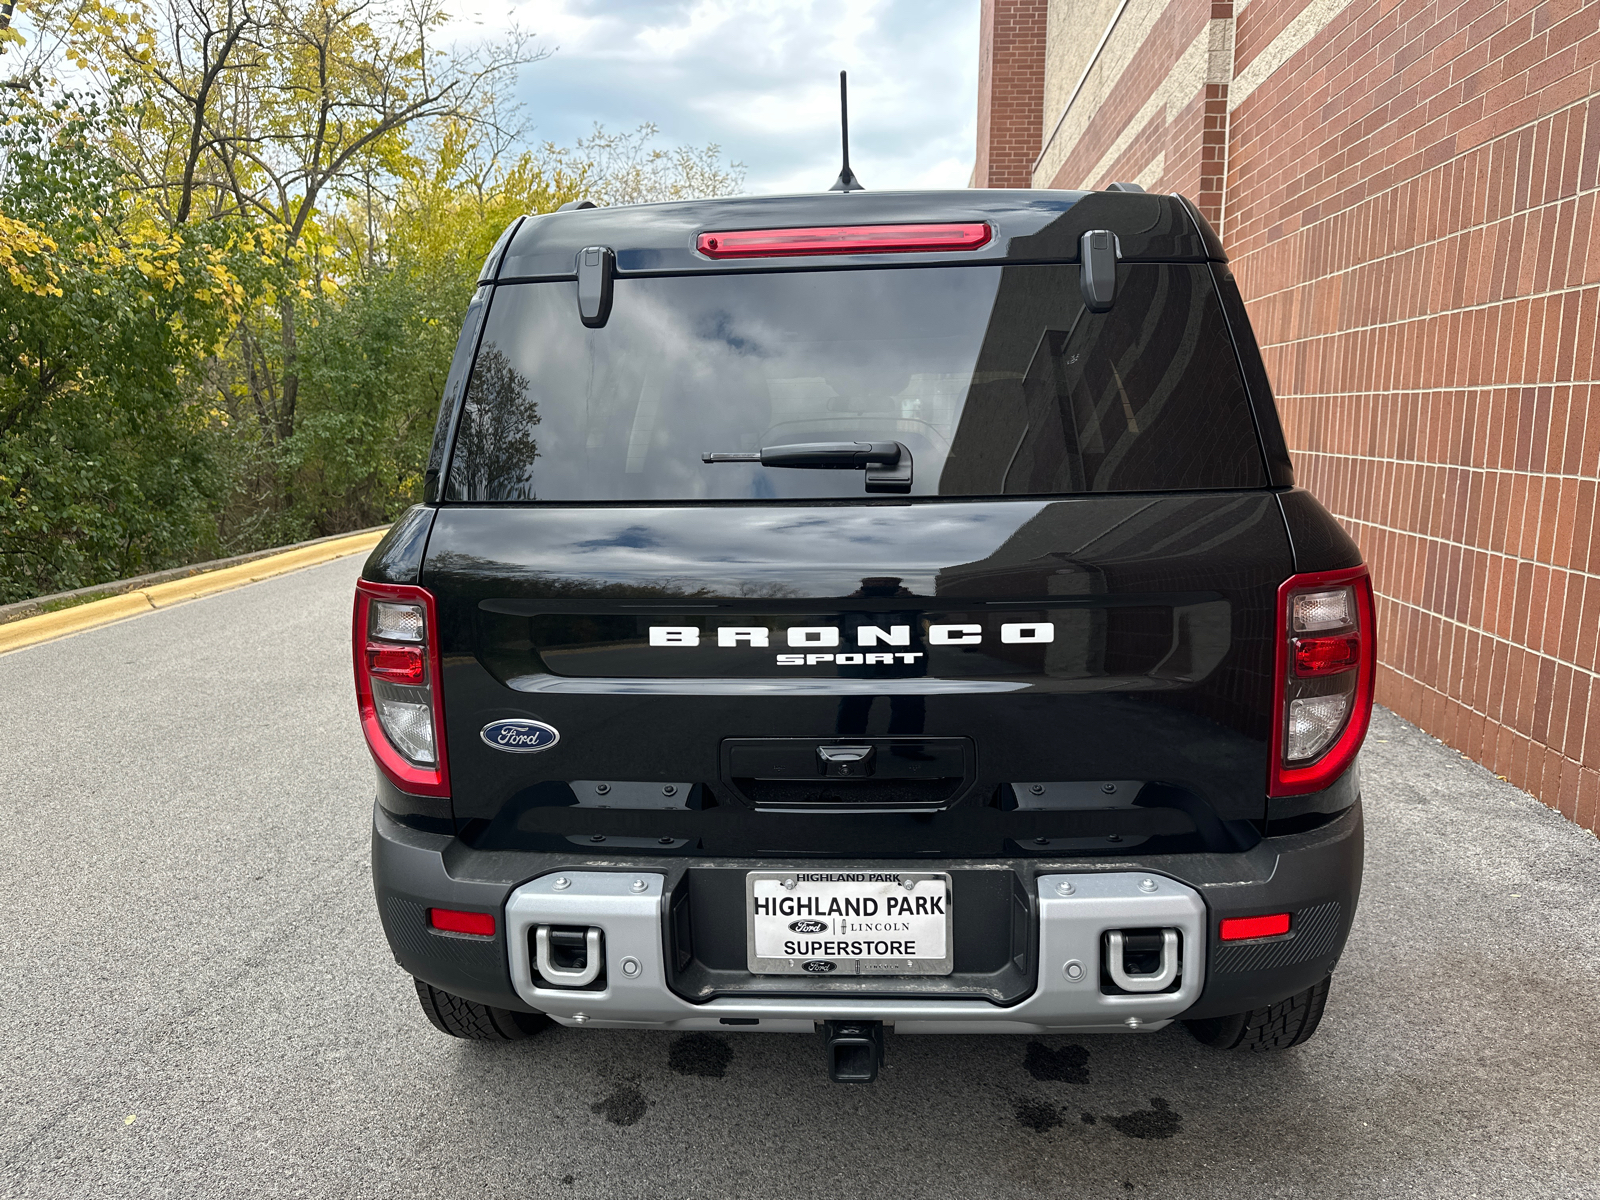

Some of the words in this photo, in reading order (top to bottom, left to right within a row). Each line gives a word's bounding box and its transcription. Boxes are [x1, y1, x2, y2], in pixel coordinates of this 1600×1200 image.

[649, 622, 1055, 647] BRONCO
[776, 652, 923, 666] SPORT
[497, 725, 540, 745] Ford
[796, 873, 865, 882] HIGHLAND
[869, 873, 901, 882] PARK
[755, 896, 878, 917] HIGHLAND
[887, 895, 945, 915] PARK
[795, 921, 821, 932] Ford
[851, 922, 910, 932] LINCOLN
[784, 940, 916, 956] SUPERSTORE
